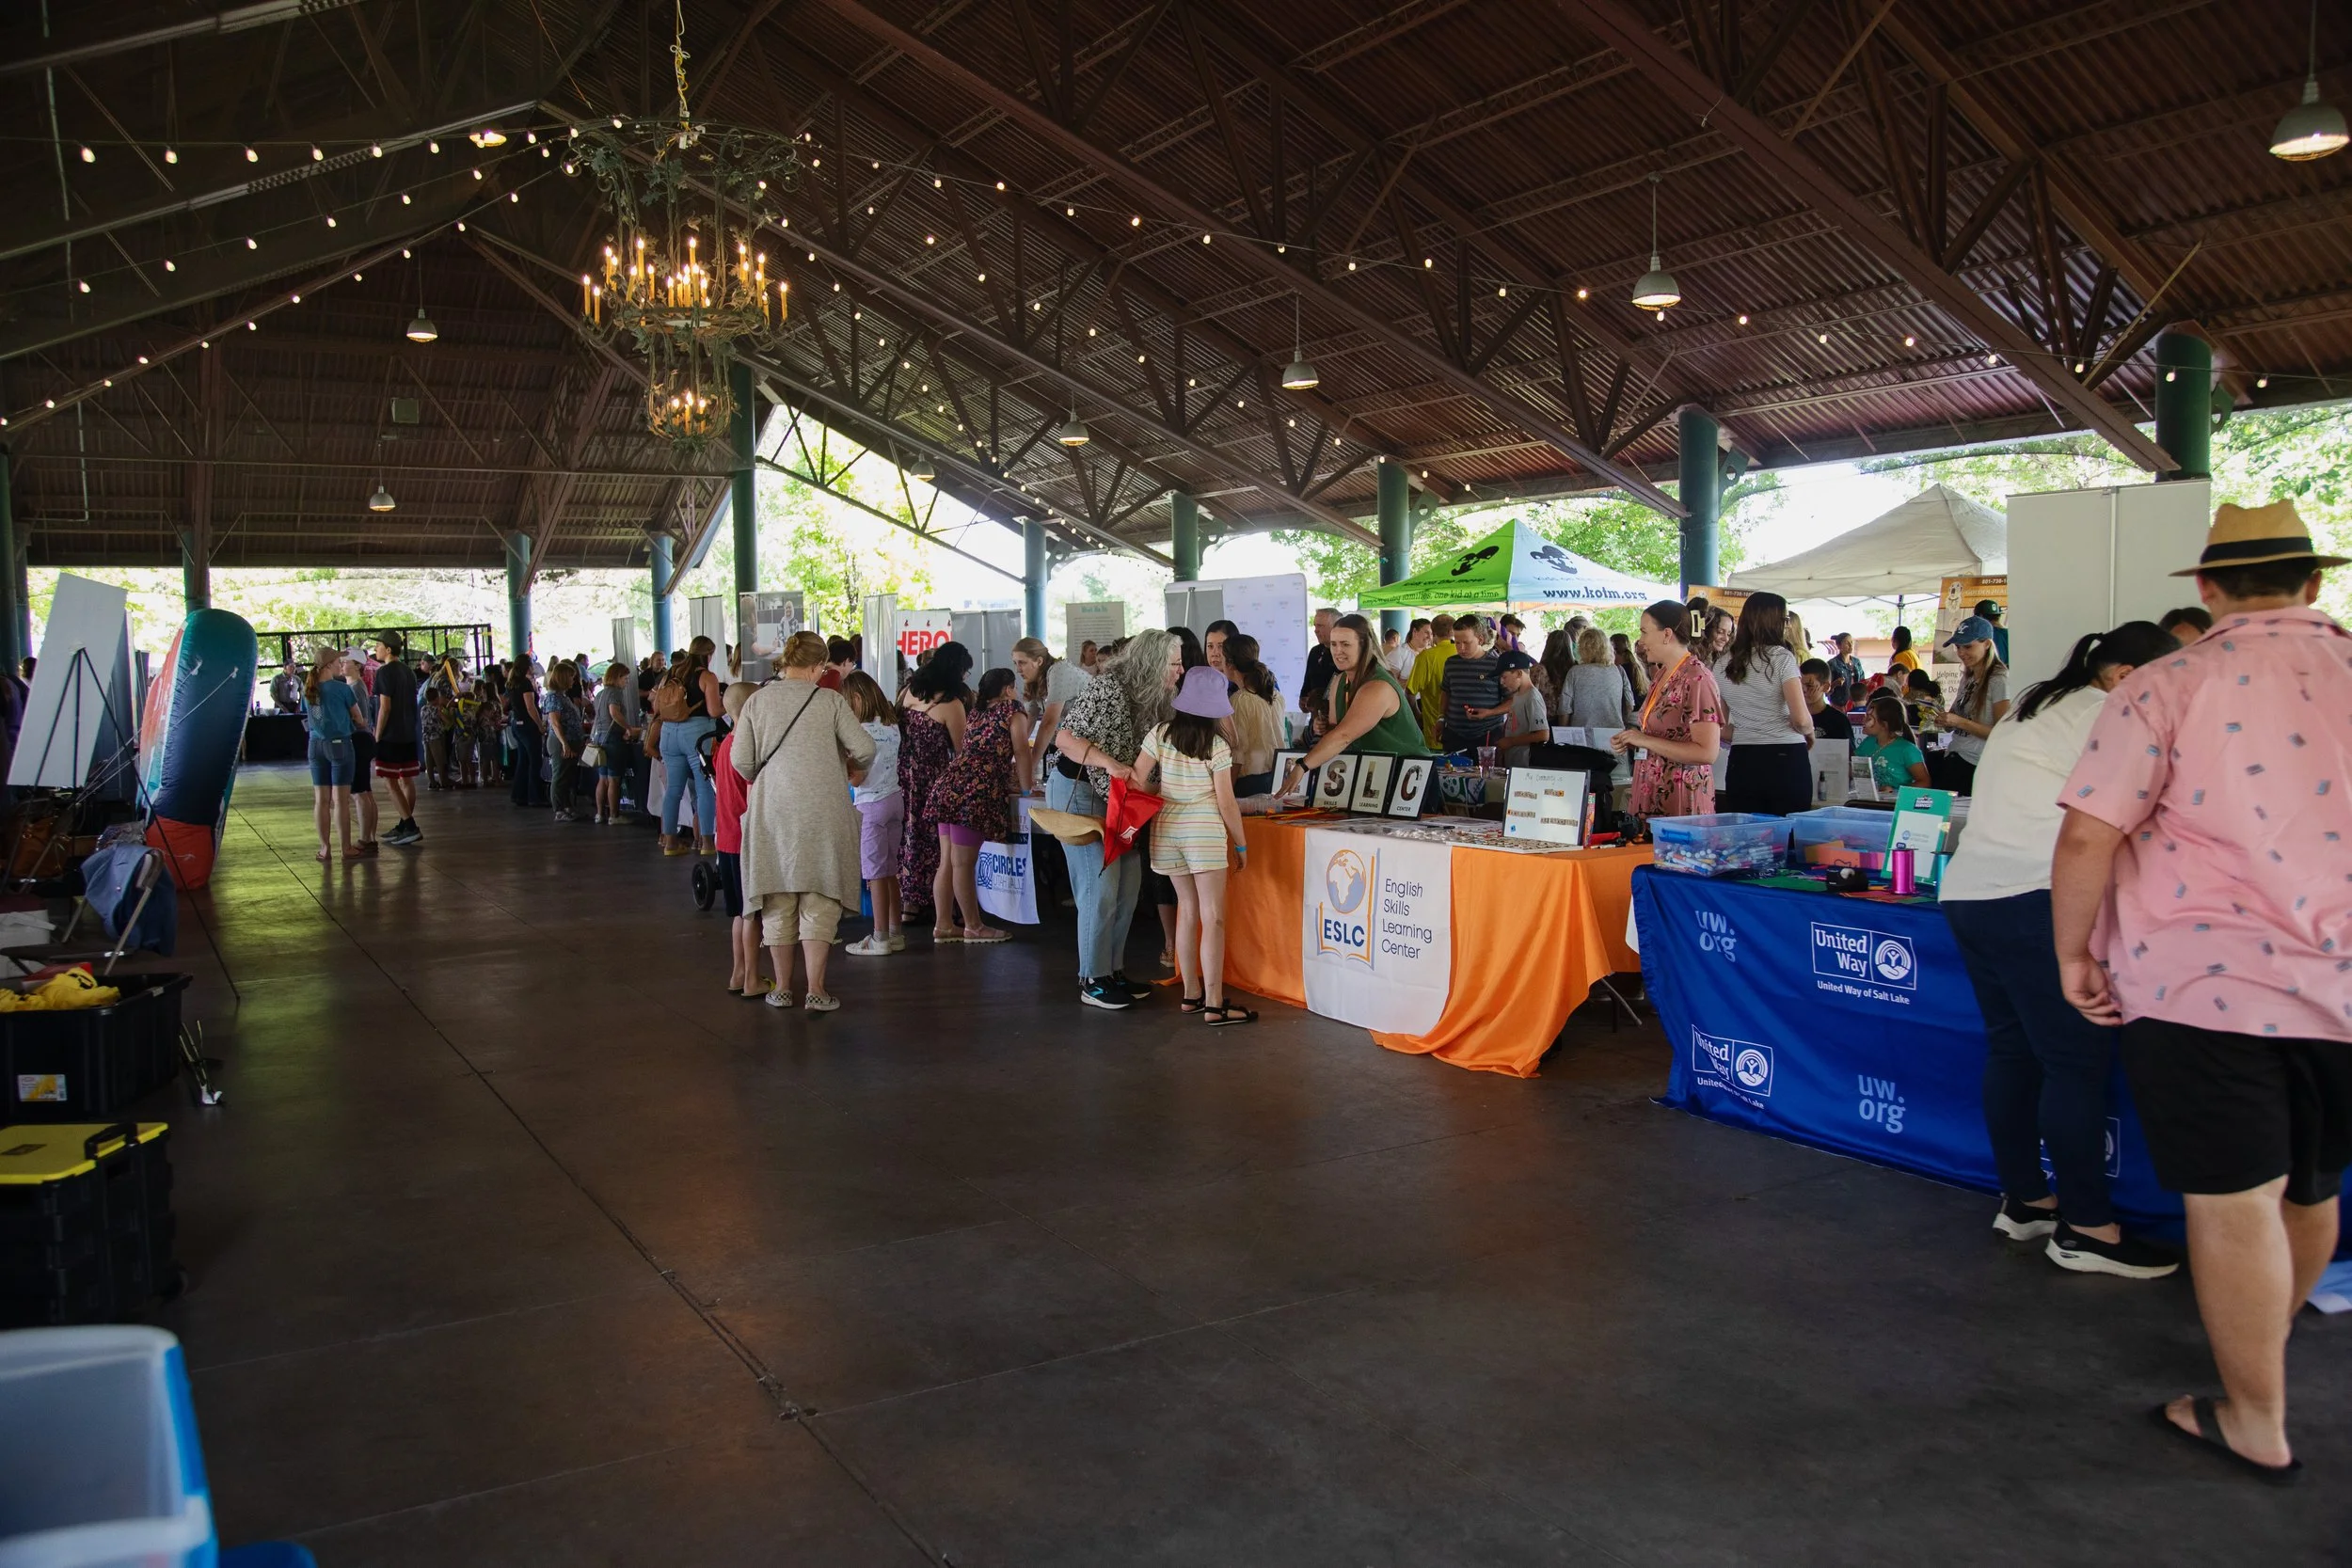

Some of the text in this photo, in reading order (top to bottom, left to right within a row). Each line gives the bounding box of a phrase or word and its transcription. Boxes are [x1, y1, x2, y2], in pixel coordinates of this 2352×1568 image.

[1324, 760, 1422, 800] S L C
[1385, 879, 1423, 898] English
[1383, 898, 1410, 916] Skills
[1324, 918, 1365, 947] ESLC
[1382, 919, 1432, 943] Learning
[1694, 910, 1735, 936] uw.
[1381, 939, 1421, 959] Center
[1699, 931, 1737, 962] org
[1815, 928, 1867, 954] United
[1836, 952, 1867, 977] Way
[1817, 979, 1910, 1006] United Way of Salt Lake
[1857, 1074, 1905, 1103] uw.
[1859, 1098, 1907, 1133] org
